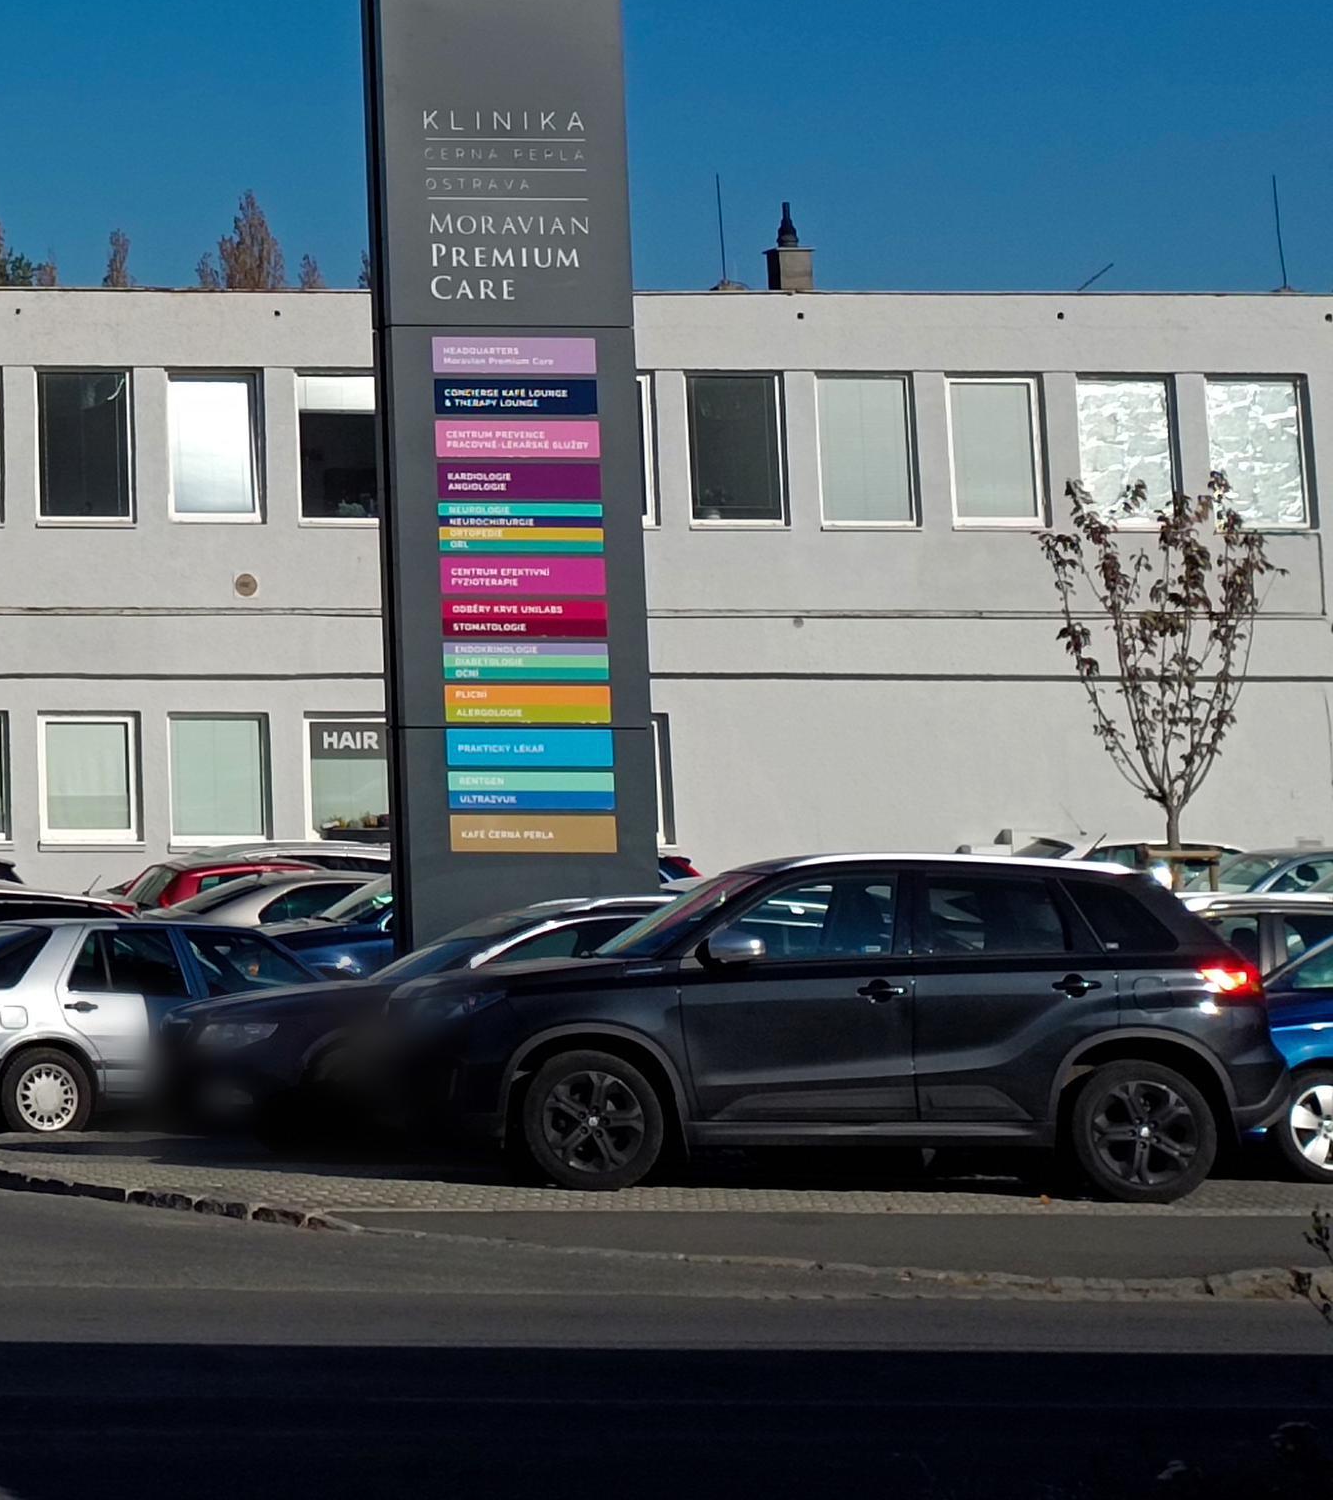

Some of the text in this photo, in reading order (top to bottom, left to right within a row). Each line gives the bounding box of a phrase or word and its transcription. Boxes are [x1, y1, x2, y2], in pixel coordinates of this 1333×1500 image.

[423, 110, 585, 131] KLINIKA
[514, 148, 584, 161] PERLA
[425, 178, 530, 190] OSTRAVA
[443, 347, 519, 356] HEADQUARTERS
[443, 357, 554, 366] Moravian Premium Care
[444, 389, 499, 398] CONCIERGE
[528, 389, 568, 398] LOUNGE
[444, 399, 540, 408] & THERAPY LOUNGE
[446, 430, 546, 440] CENTRUM PREVENCE
[447, 472, 512, 482] KARDIOLOGIE
[448, 482, 507, 492] ANGIOLOGIE
[449, 505, 511, 514] NEUROLOGIE
[449, 517, 535, 527] NEUROCHIRURGIE
[450, 529, 503, 538] ORTOPEDIE
[451, 567, 550, 577] CENTRUM EFEKTIVNÍ
[451, 577, 518, 587] FYZIOTERAPIE
[493, 605, 518, 614] KRVE
[521, 605, 564, 614] UNILABS
[453, 622, 527, 632] STOMATOLOGIE
[455, 645, 538, 654] ENDOKRINOLOGIE
[455, 657, 523, 666] DIABETOLOGIE
[456, 708, 523, 717] ALERGOLOGIE
[323, 731, 379, 750] HAIR
[459, 776, 505, 786] RENTGEN
[459, 795, 517, 804] ULTRAZVUK
[523, 830, 555, 839] PERLA
